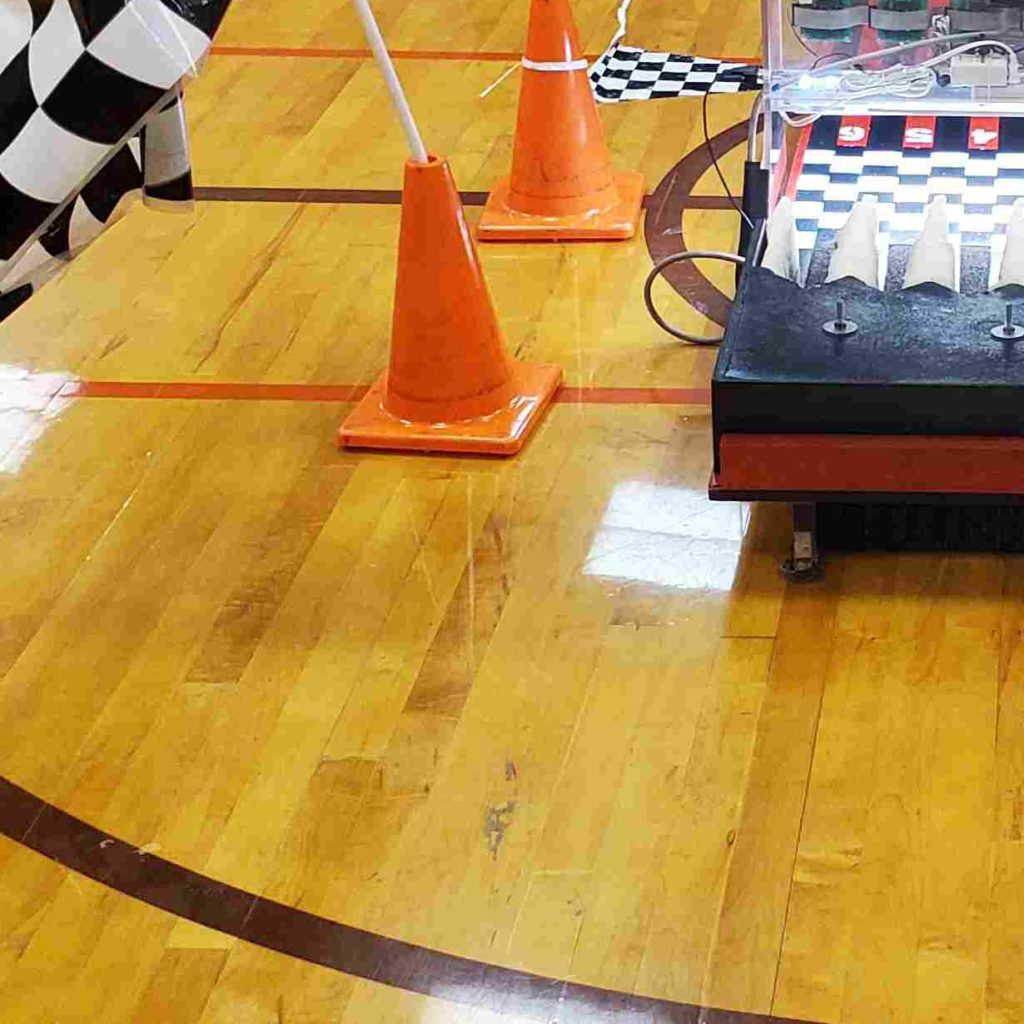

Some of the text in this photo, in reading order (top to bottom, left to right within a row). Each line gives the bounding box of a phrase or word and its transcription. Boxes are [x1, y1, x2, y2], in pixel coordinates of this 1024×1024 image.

[838, 125, 866, 142] 6
[904, 127, 935, 143] 5
[970, 128, 999, 145] 4
